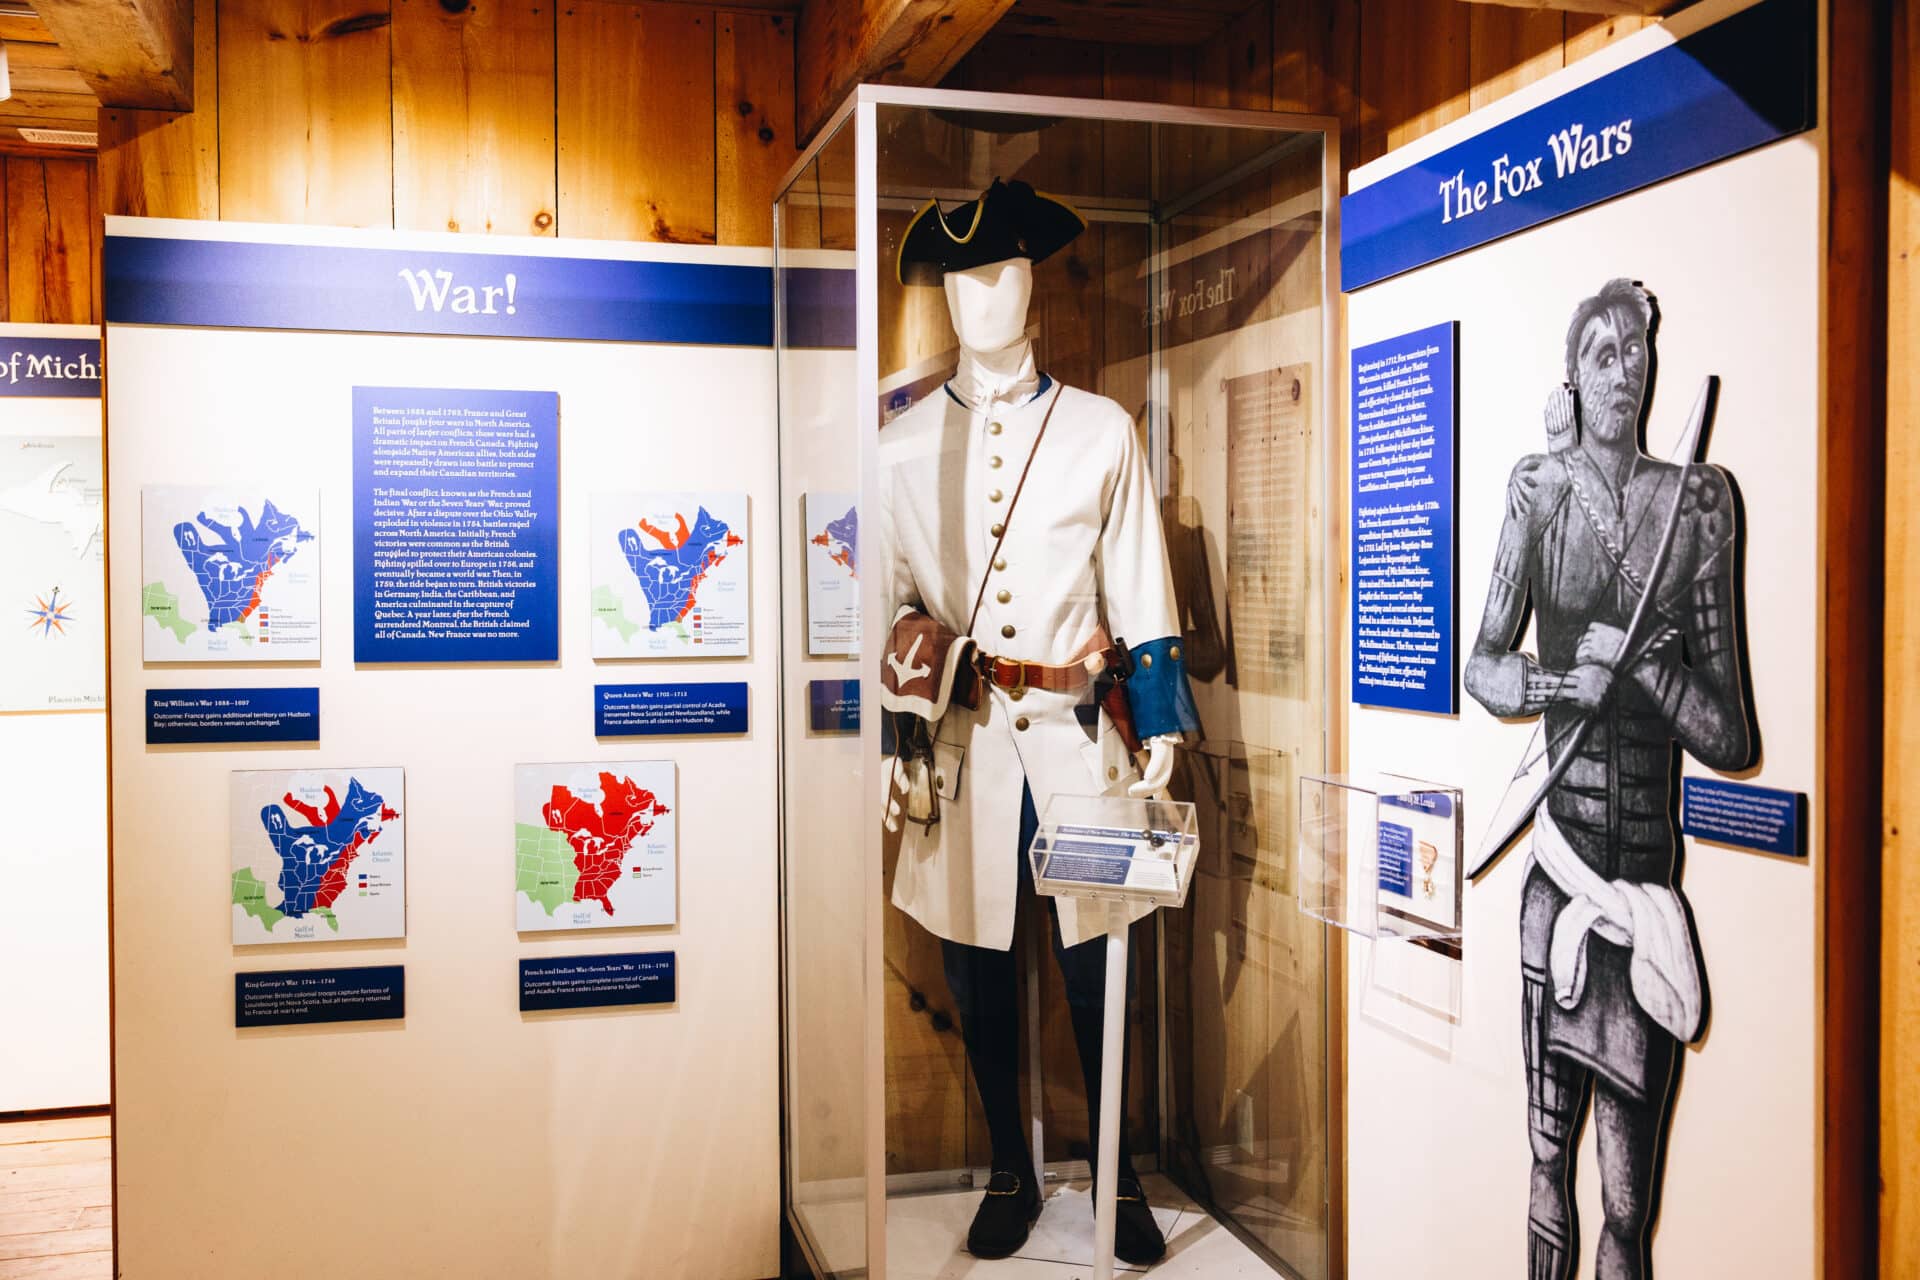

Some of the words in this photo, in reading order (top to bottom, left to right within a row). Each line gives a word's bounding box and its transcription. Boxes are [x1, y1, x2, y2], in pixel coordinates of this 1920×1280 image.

[1439, 169, 1487, 224] The
[1492, 153, 1543, 204] Fox
[1547, 119, 1632, 178] Wars
[398, 268, 517, 315] War!
